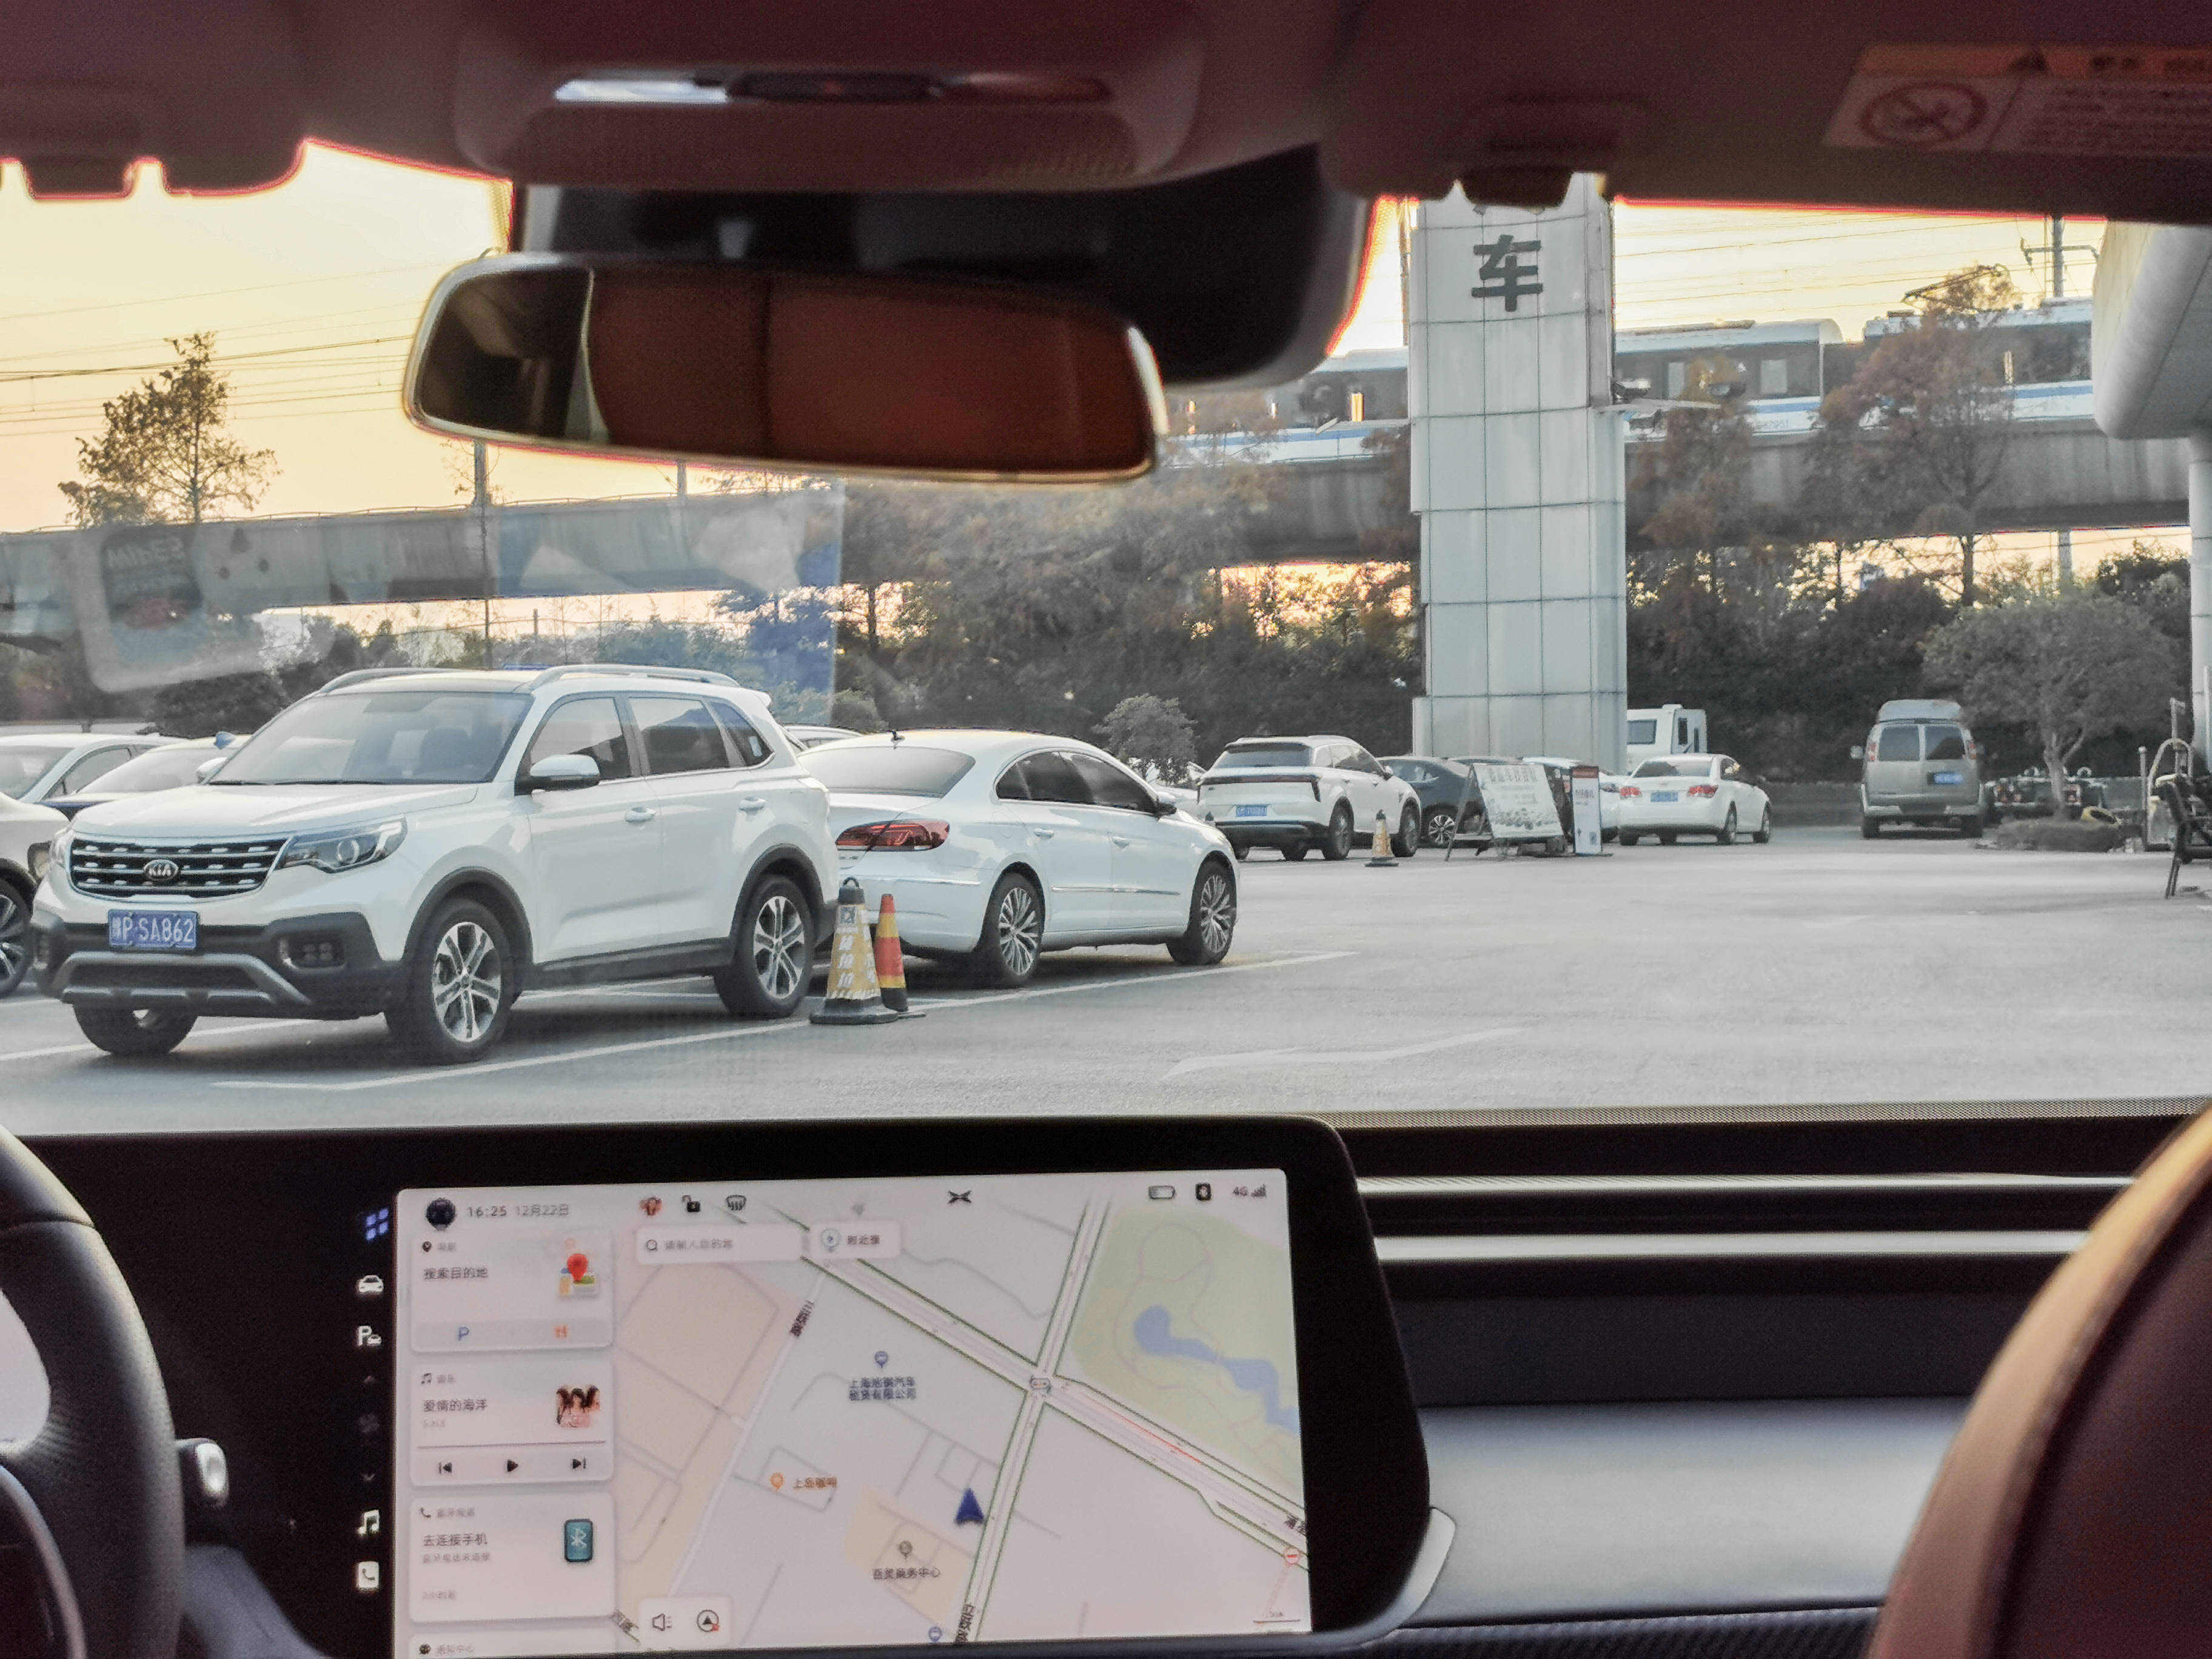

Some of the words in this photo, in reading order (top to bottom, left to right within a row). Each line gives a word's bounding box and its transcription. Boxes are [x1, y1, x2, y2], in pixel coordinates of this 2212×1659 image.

[1471, 234, 1543, 312] 车
[148, 863, 171, 876] KIA
[467, 1205, 507, 1218] 16:25
[515, 1204, 569, 1217] 12月22日
[423, 1266, 488, 1279] 搜索目的地
[423, 1399, 488, 1412] 爱情的海洋
[423, 1533, 488, 1546] 去连接手机
